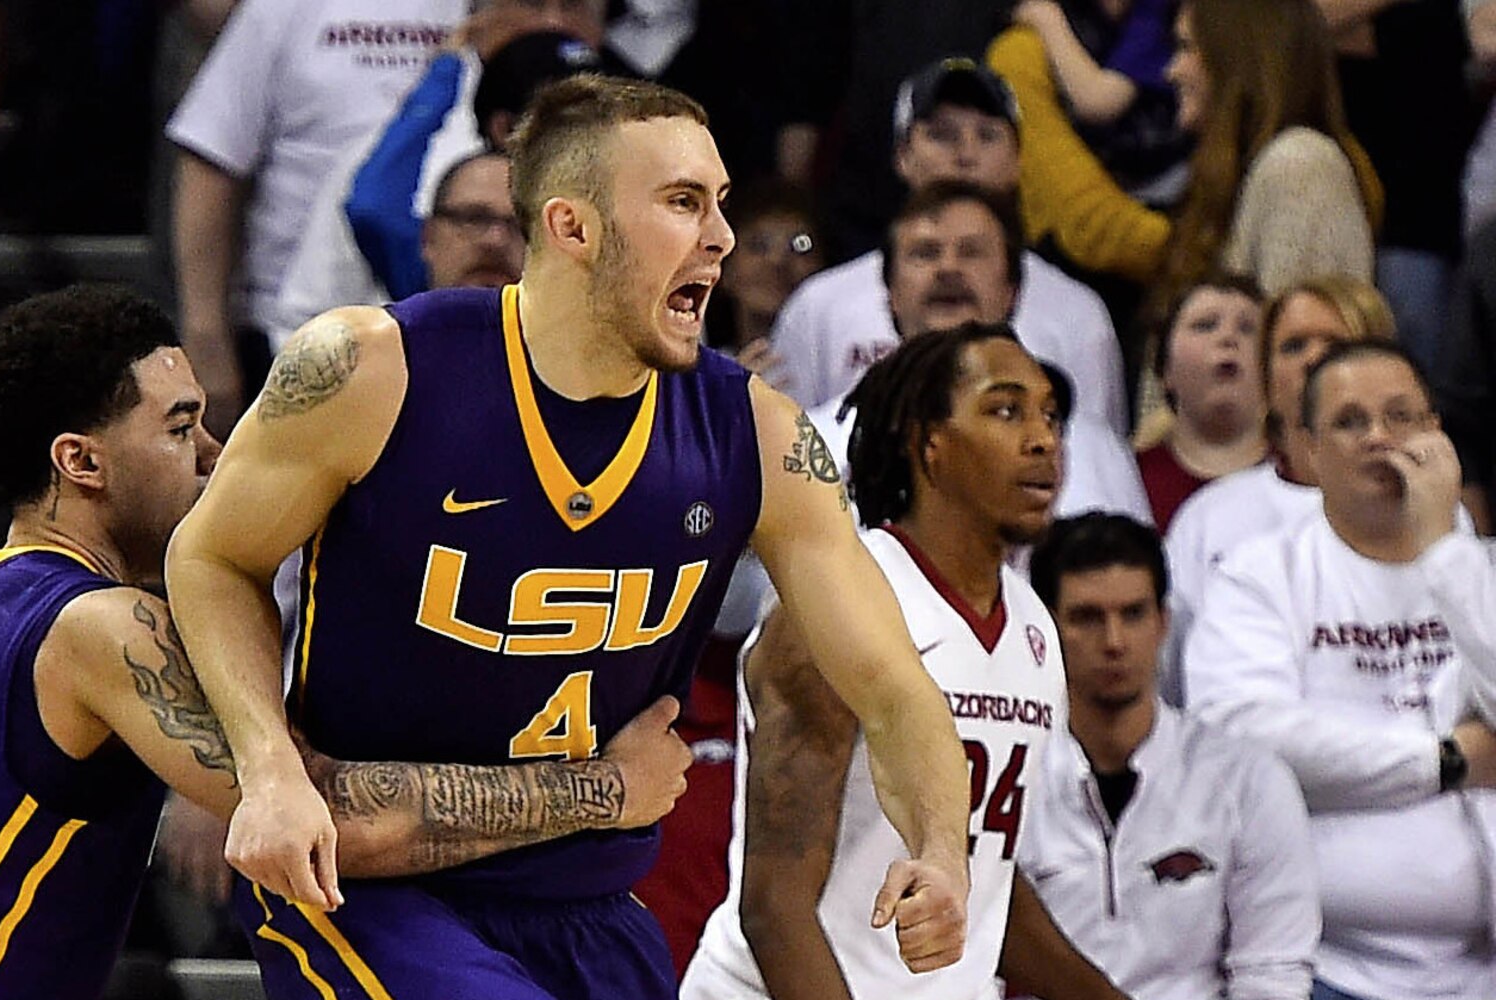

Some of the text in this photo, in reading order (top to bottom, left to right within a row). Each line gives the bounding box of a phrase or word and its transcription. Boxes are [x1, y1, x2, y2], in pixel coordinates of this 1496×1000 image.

[686, 502, 712, 535] SEC
[415, 544, 708, 655] LSU
[509, 671, 597, 761] 4
